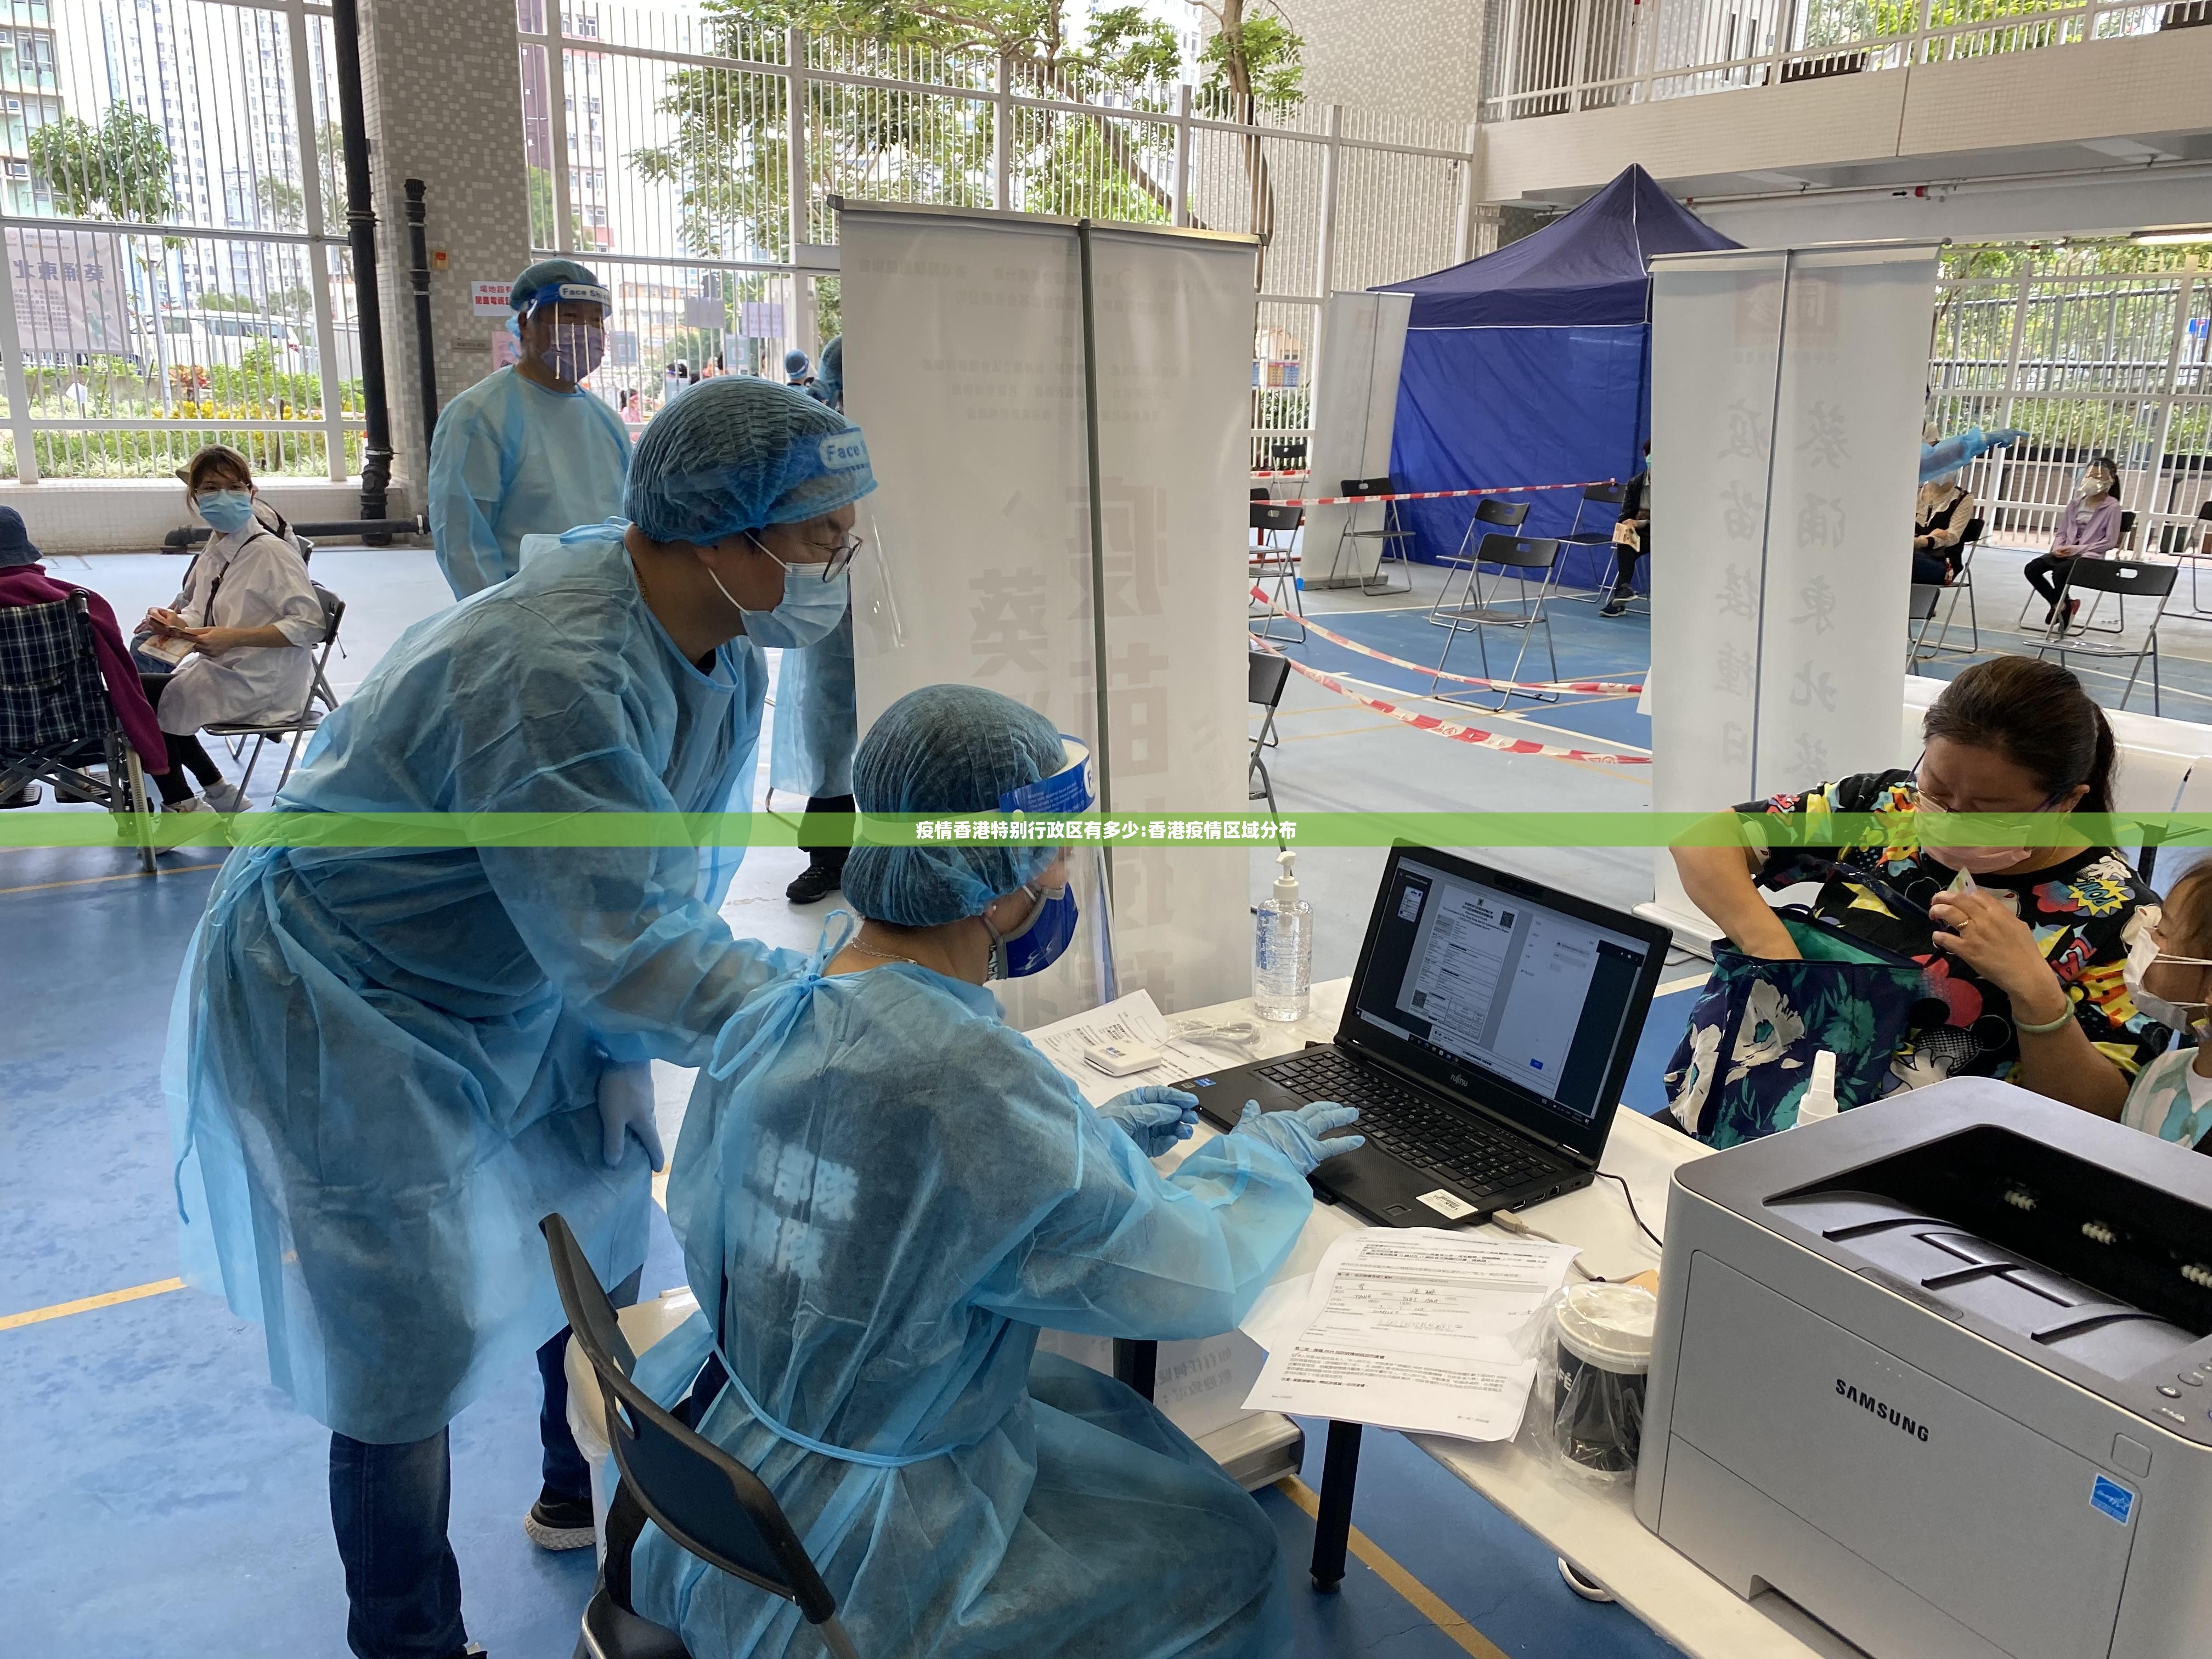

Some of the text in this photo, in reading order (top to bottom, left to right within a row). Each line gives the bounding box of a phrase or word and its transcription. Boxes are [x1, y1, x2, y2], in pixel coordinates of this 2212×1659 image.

[562, 287, 587, 296] Face
[826, 444, 860, 462] Face
[1450, 1073, 1468, 1087] FUJITSU
[1835, 1378, 1929, 1443] SAMSUNG
